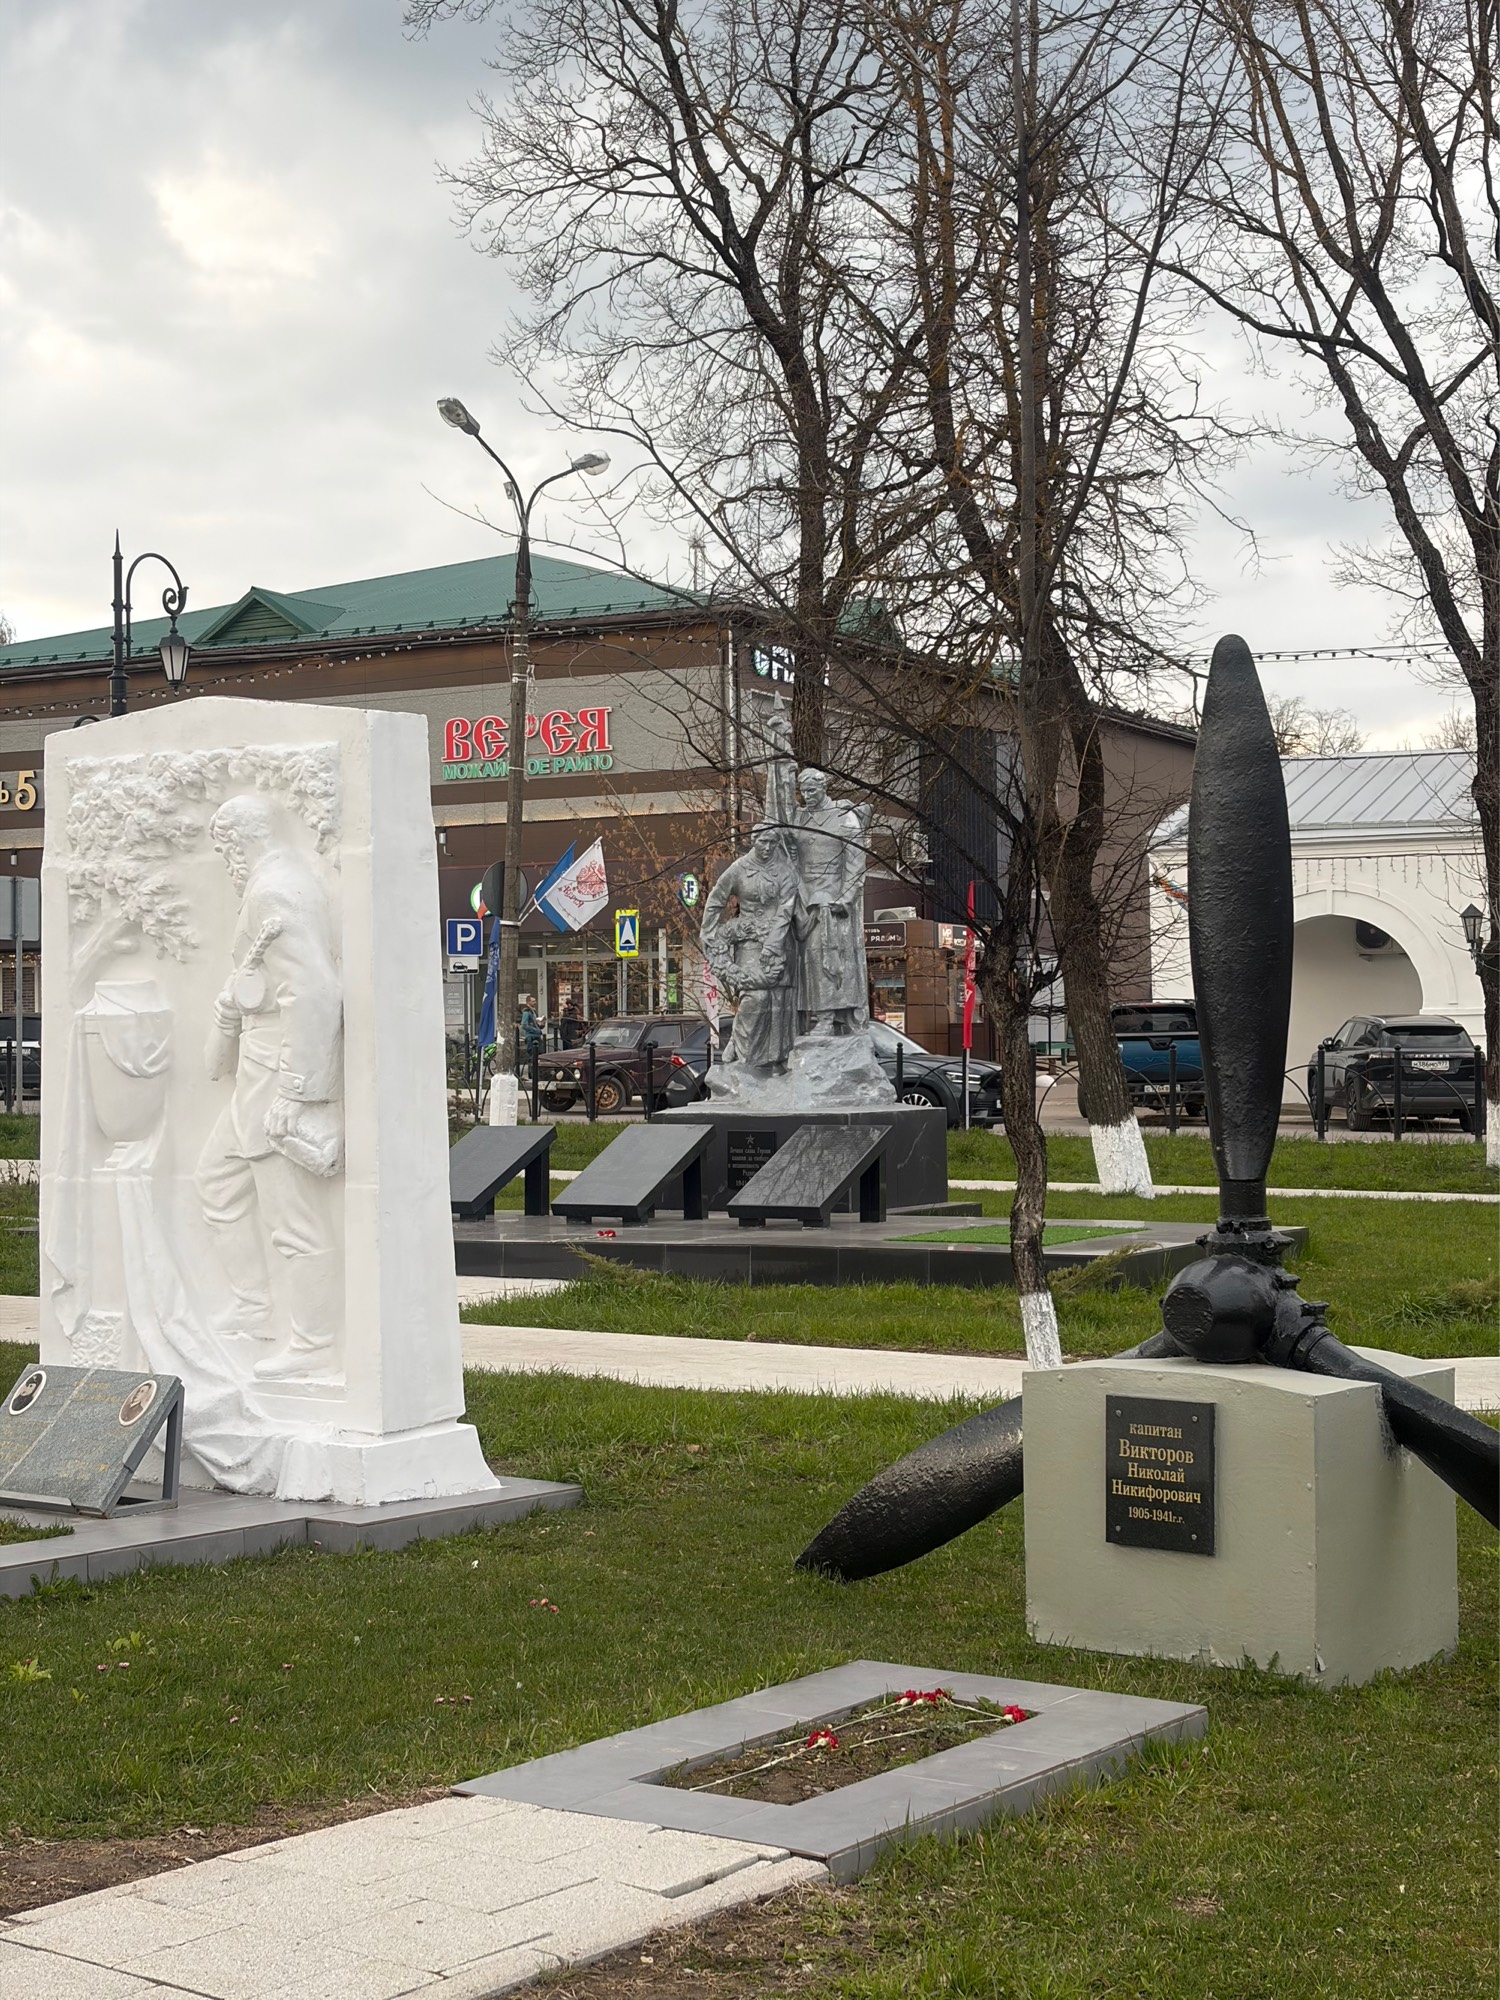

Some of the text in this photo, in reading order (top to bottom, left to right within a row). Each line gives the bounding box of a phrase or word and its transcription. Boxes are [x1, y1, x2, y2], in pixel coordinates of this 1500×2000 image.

[443, 758, 550, 781] МОЖАЙОЕ
[15, 771, 36, 811] 5
[457, 924, 476, 952] P
[1129, 1423, 1183, 1439] капитан
[1119, 1439, 1194, 1466] Викторов
[1127, 1461, 1185, 1483] Николай
[1111, 1479, 1202, 1504] Никифорович
[1128, 1506, 1185, 1525] 1905-1941г.г.
